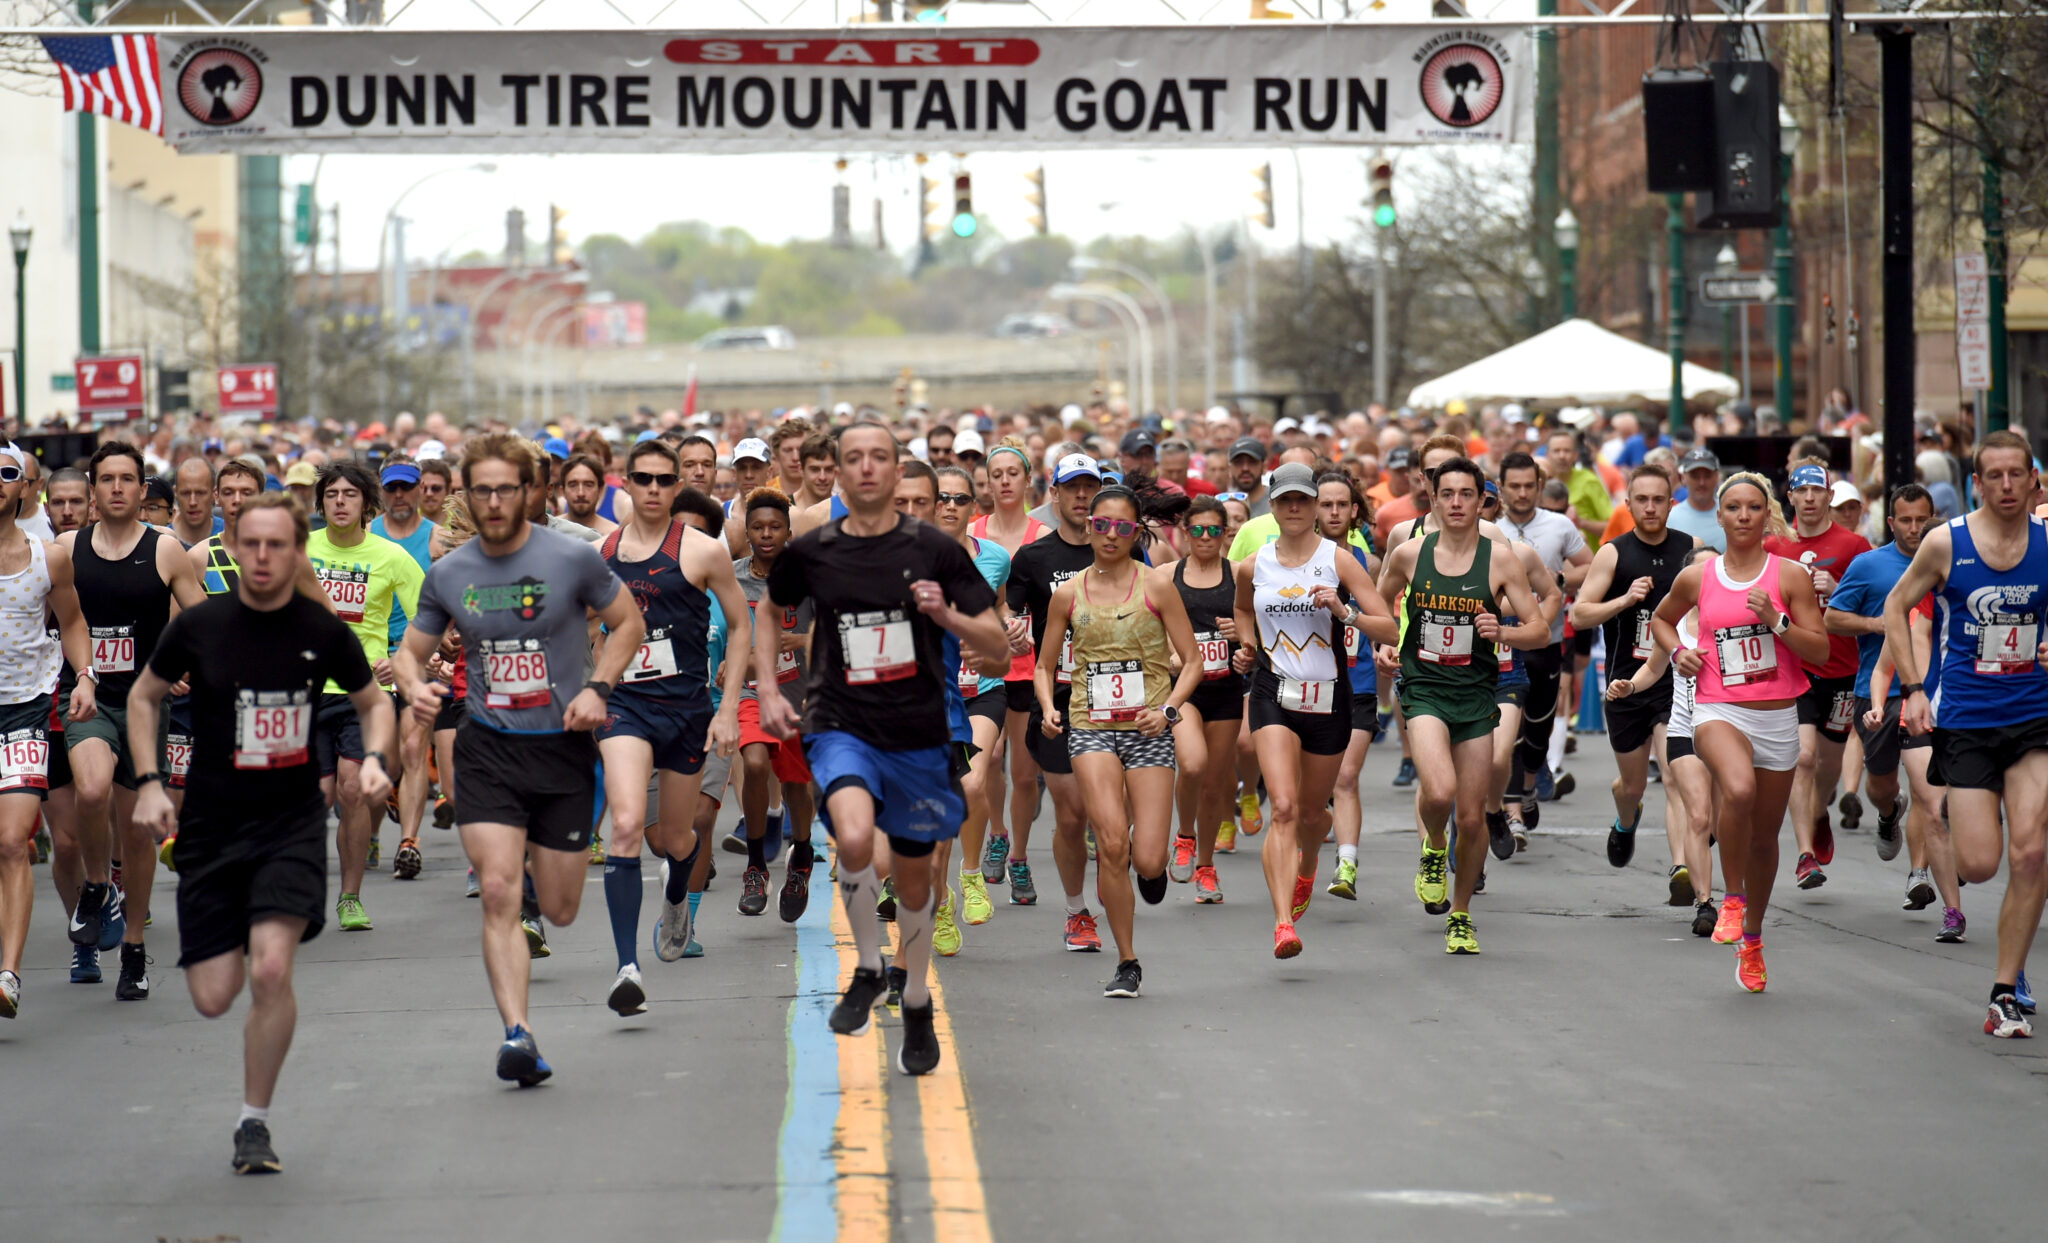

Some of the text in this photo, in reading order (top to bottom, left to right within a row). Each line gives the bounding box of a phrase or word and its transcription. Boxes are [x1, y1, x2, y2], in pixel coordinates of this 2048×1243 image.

[699, 41, 1005, 64] START
[290, 74, 1388, 132] DUNN TIRE MOUNTAIN GOAT RUN
[80, 364, 98, 387] 7
[118, 362, 137, 385] 9
[221, 371, 238, 392] 9
[252, 371, 275, 391] 11
[322, 580, 366, 605] 2303
[1996, 585, 2039, 593] SYRACUSE
[1265, 601, 1317, 613] acidotic
[1415, 592, 1484, 614] CLARKSON
[872, 627, 886, 654] 7
[1442, 626, 1455, 647] 9
[2005, 627, 2018, 651] 4
[640, 645, 653, 670] 2
[1738, 637, 1762, 662] 10
[489, 653, 546, 682] 2268
[1111, 674, 1124, 699] 3
[1300, 681, 1320, 704] 11
[254, 707, 301, 741] 581
[3, 740, 49, 767] 1567
